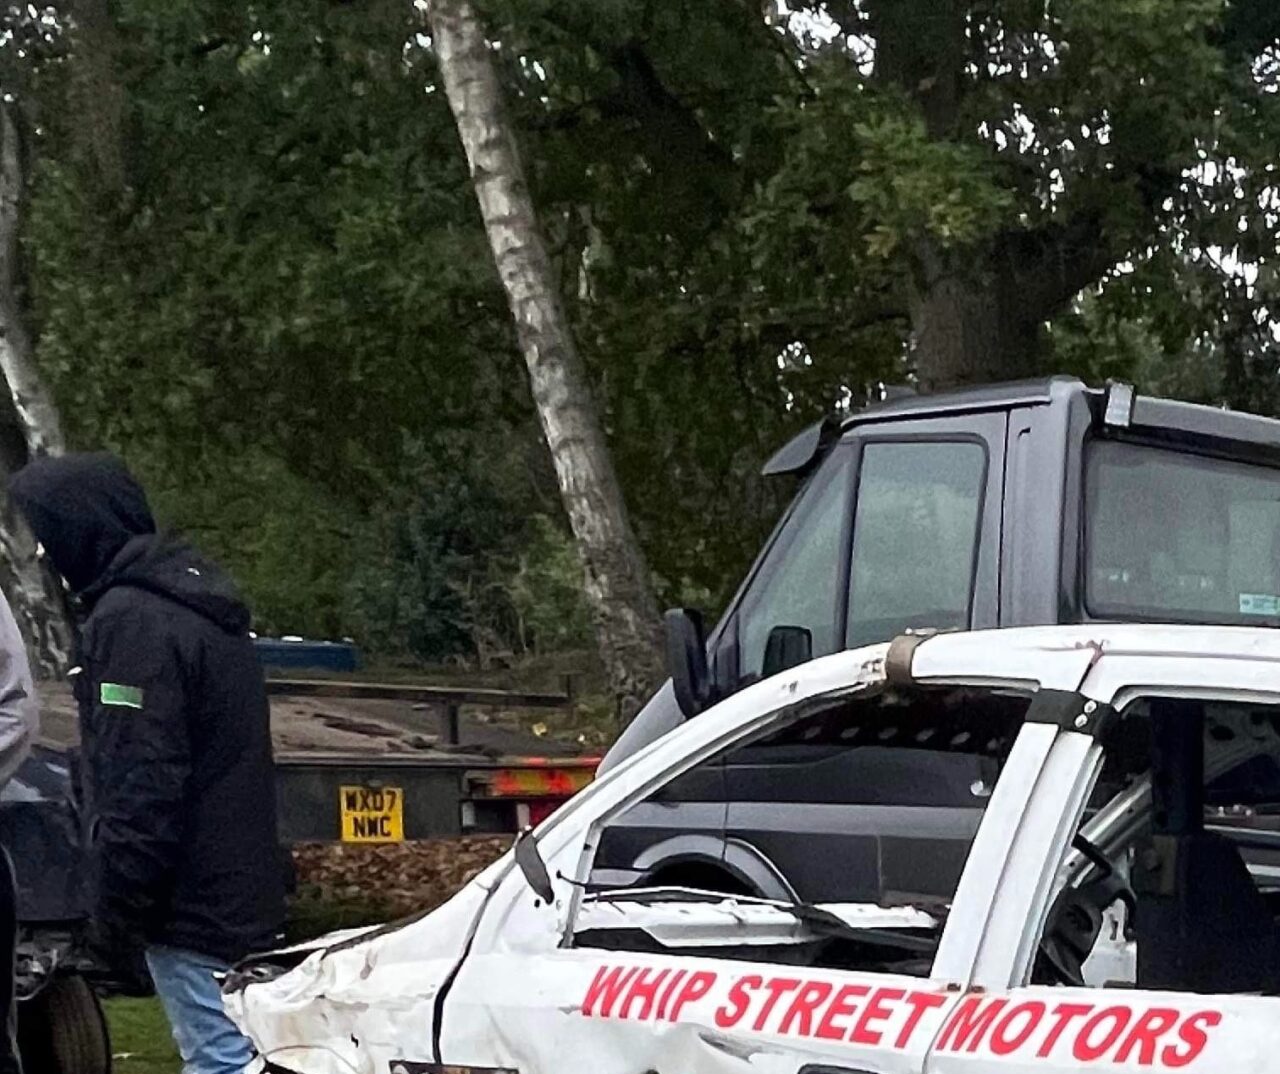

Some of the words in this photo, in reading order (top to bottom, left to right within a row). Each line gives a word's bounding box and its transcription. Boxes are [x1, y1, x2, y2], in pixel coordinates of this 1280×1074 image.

[582, 965, 717, 1022] WHIP
[715, 974, 947, 1048] STREET
[936, 995, 1223, 1067] MOTORS
